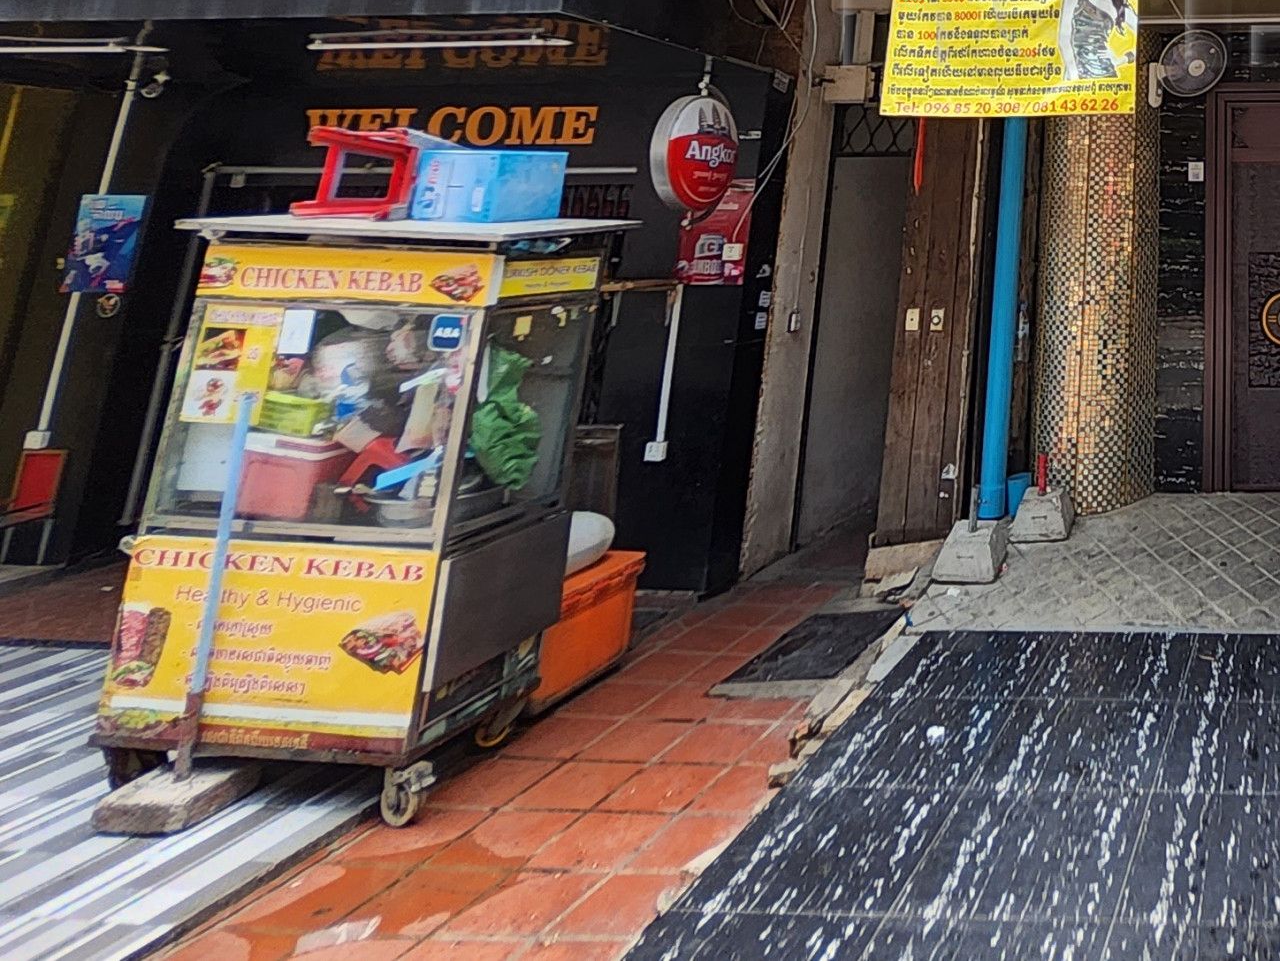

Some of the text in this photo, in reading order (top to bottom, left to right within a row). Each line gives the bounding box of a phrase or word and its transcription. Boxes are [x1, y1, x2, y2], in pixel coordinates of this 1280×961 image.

[924, 102, 949, 114] 096
[953, 102, 971, 113] 85
[974, 102, 991, 114] 20
[994, 101, 1020, 113] 308
[1033, 100, 1058, 112] 081
[1060, 99, 1078, 112] 43
[1080, 98, 1098, 111] 62
[1101, 98, 1119, 111] 26
[240, 267, 424, 294] CHICKEN KEBAB
[133, 548, 424, 582] CHICKEN KEBAB
[175, 584, 363, 613] Hethy & Hygienic
